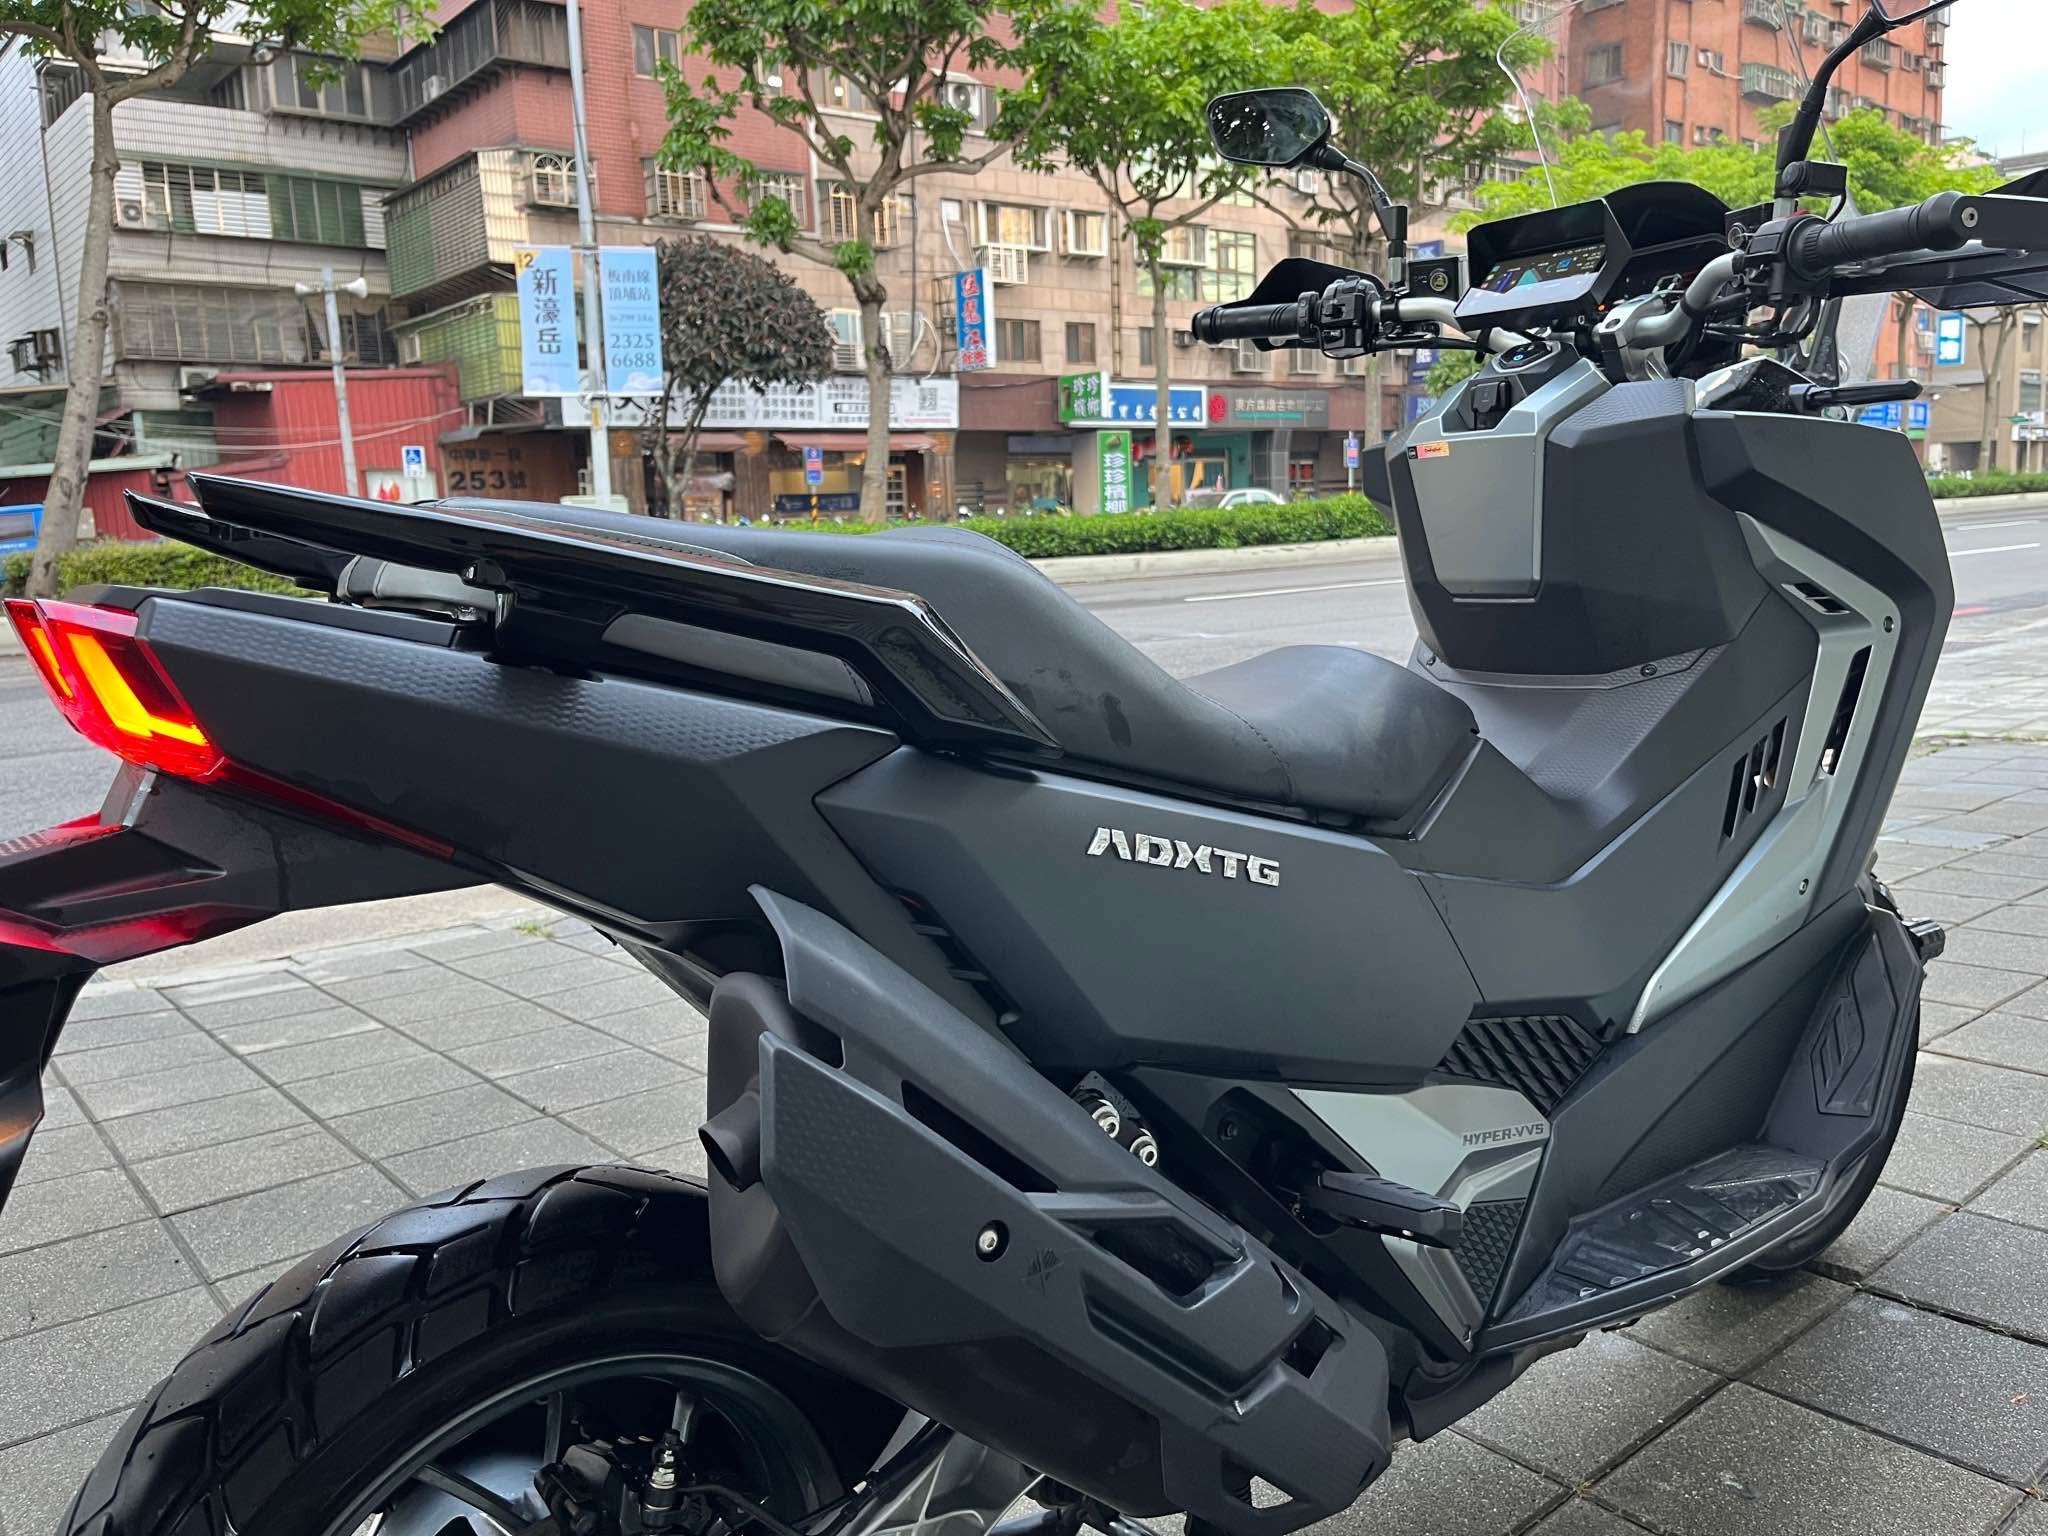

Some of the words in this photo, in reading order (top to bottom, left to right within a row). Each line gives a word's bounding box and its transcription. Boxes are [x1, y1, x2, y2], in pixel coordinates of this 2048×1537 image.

[531, 267, 561, 355] 新濠岳
[611, 333, 654, 349] 2325
[611, 353, 656, 369] 6688
[1103, 453, 1127, 513] 珍珍檳榔
[1087, 826, 1280, 887] ADXTG
